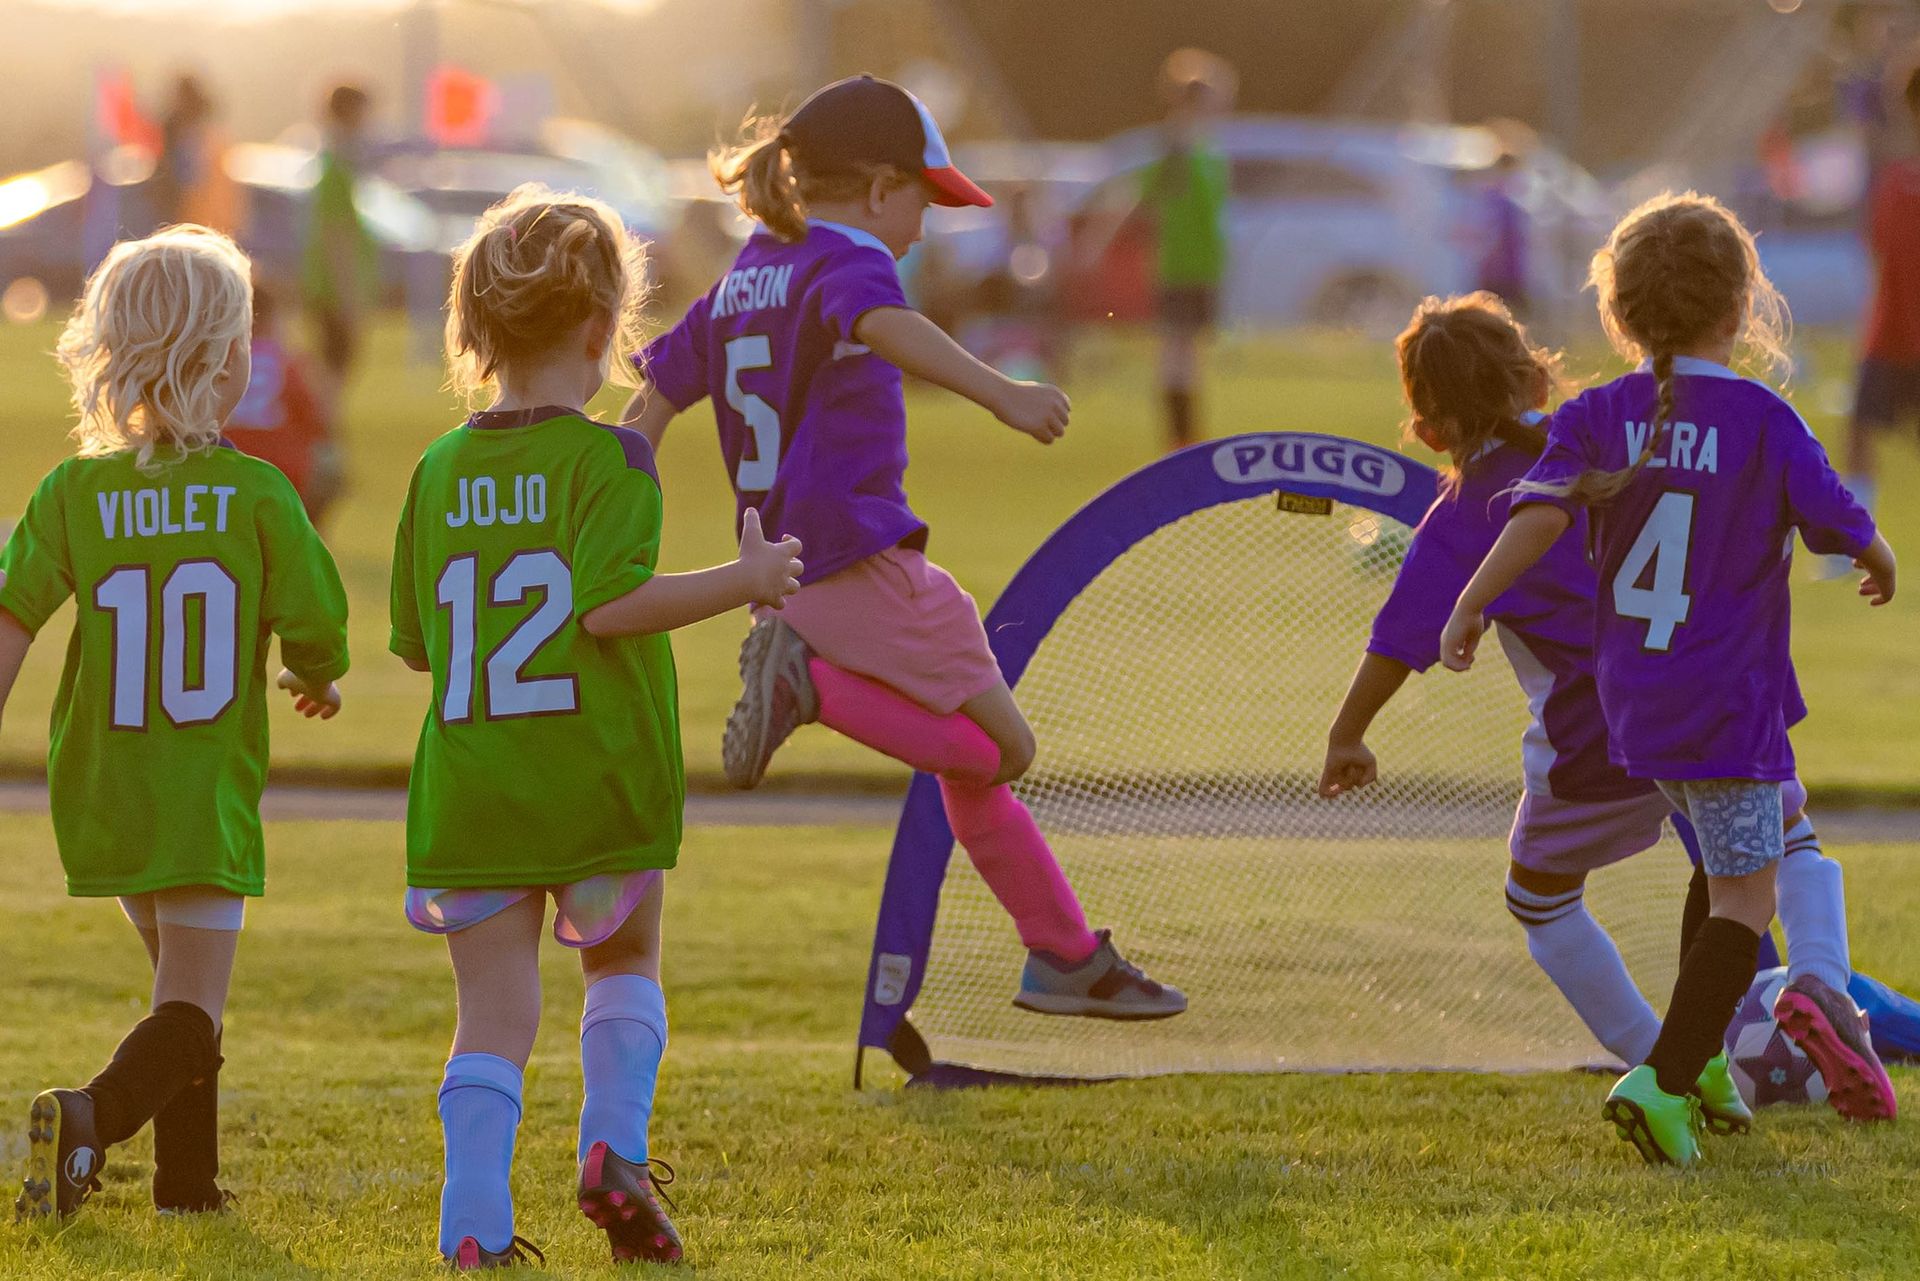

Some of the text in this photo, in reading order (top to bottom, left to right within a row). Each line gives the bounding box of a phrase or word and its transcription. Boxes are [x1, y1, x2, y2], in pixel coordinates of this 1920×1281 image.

[724, 334, 782, 492] 5
[1233, 442, 1385, 488] PUGG
[97, 484, 237, 539] VIOLET
[446, 474, 547, 527] JOJO
[1612, 490, 1694, 651] 4
[92, 557, 241, 733] 10
[435, 549, 580, 725] 12
